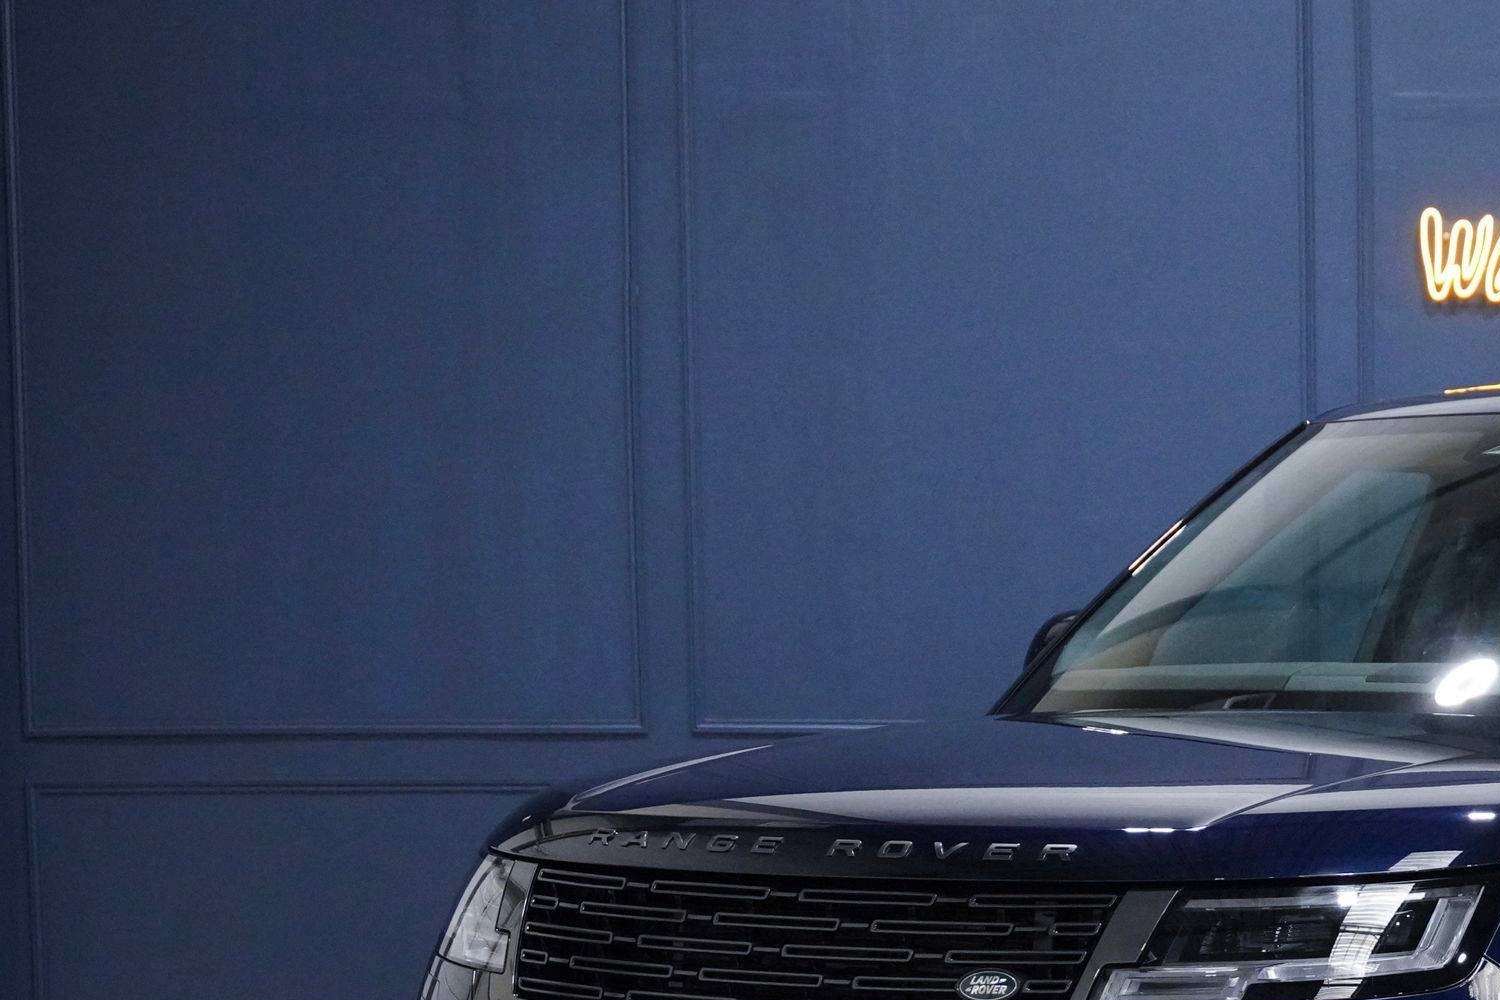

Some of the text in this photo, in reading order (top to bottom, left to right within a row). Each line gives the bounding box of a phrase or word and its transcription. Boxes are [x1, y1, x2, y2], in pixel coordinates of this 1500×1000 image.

[588, 827, 1078, 862] RANGE ROVER
[969, 975, 1000, 985] LAND
[970, 984, 1008, 995] ROVER
